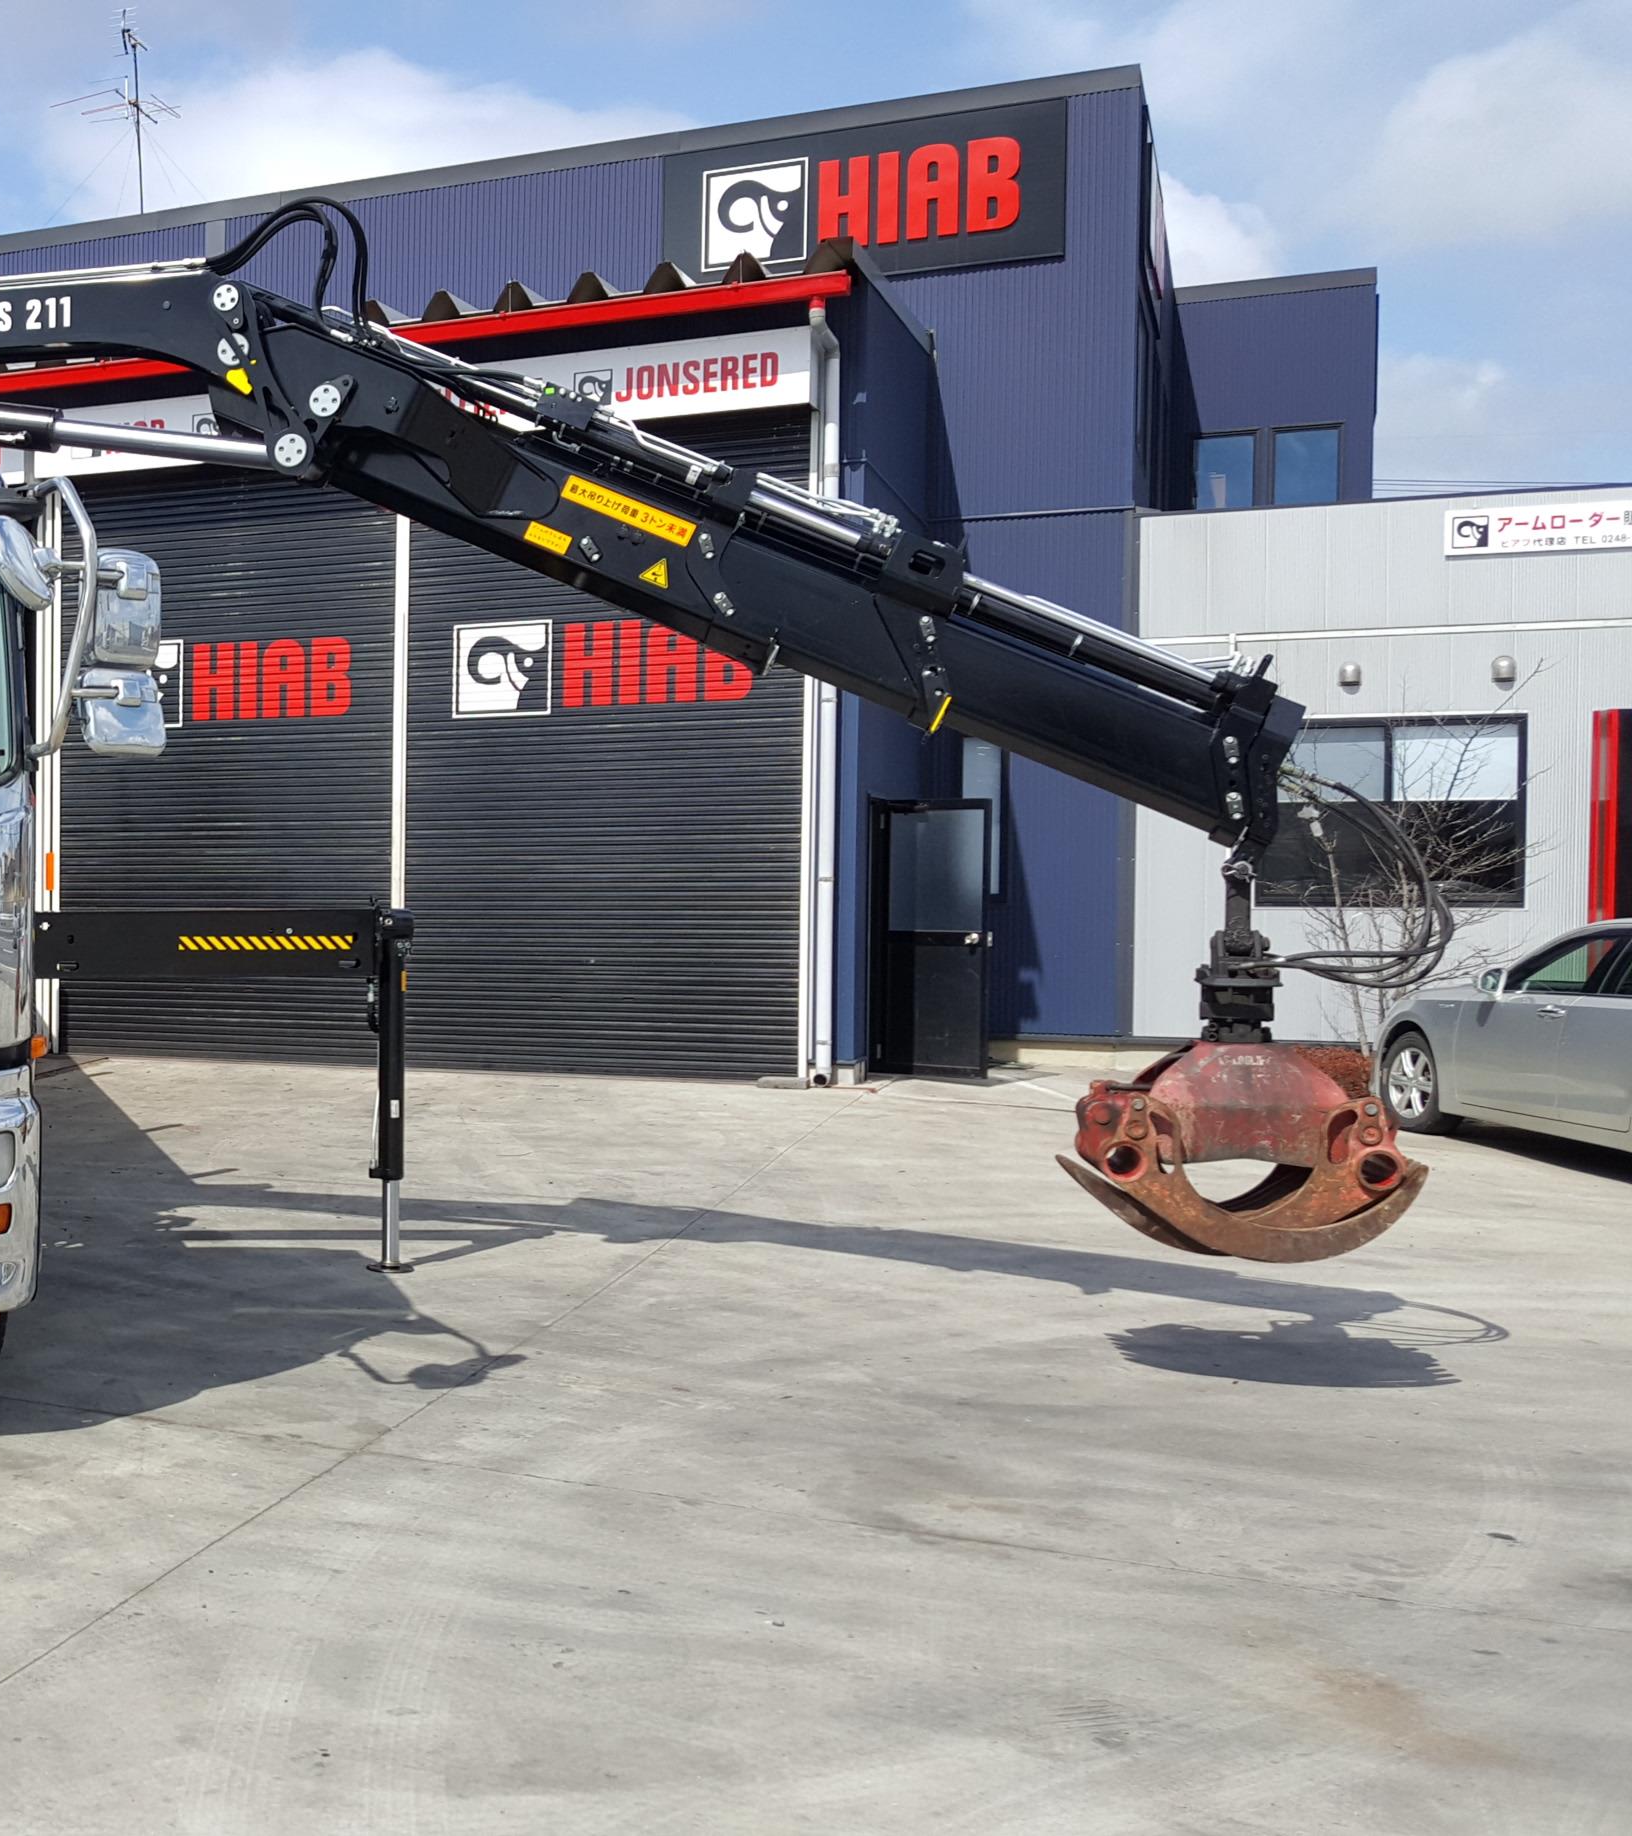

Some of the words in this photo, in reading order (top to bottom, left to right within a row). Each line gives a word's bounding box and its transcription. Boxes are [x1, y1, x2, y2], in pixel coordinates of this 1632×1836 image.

[817, 136, 1021, 247] HIAB
[25, 295, 72, 331] 211
[615, 350, 780, 403] JONSERED
[1574, 535, 1597, 545] TEL
[191, 636, 352, 721] HIAB
